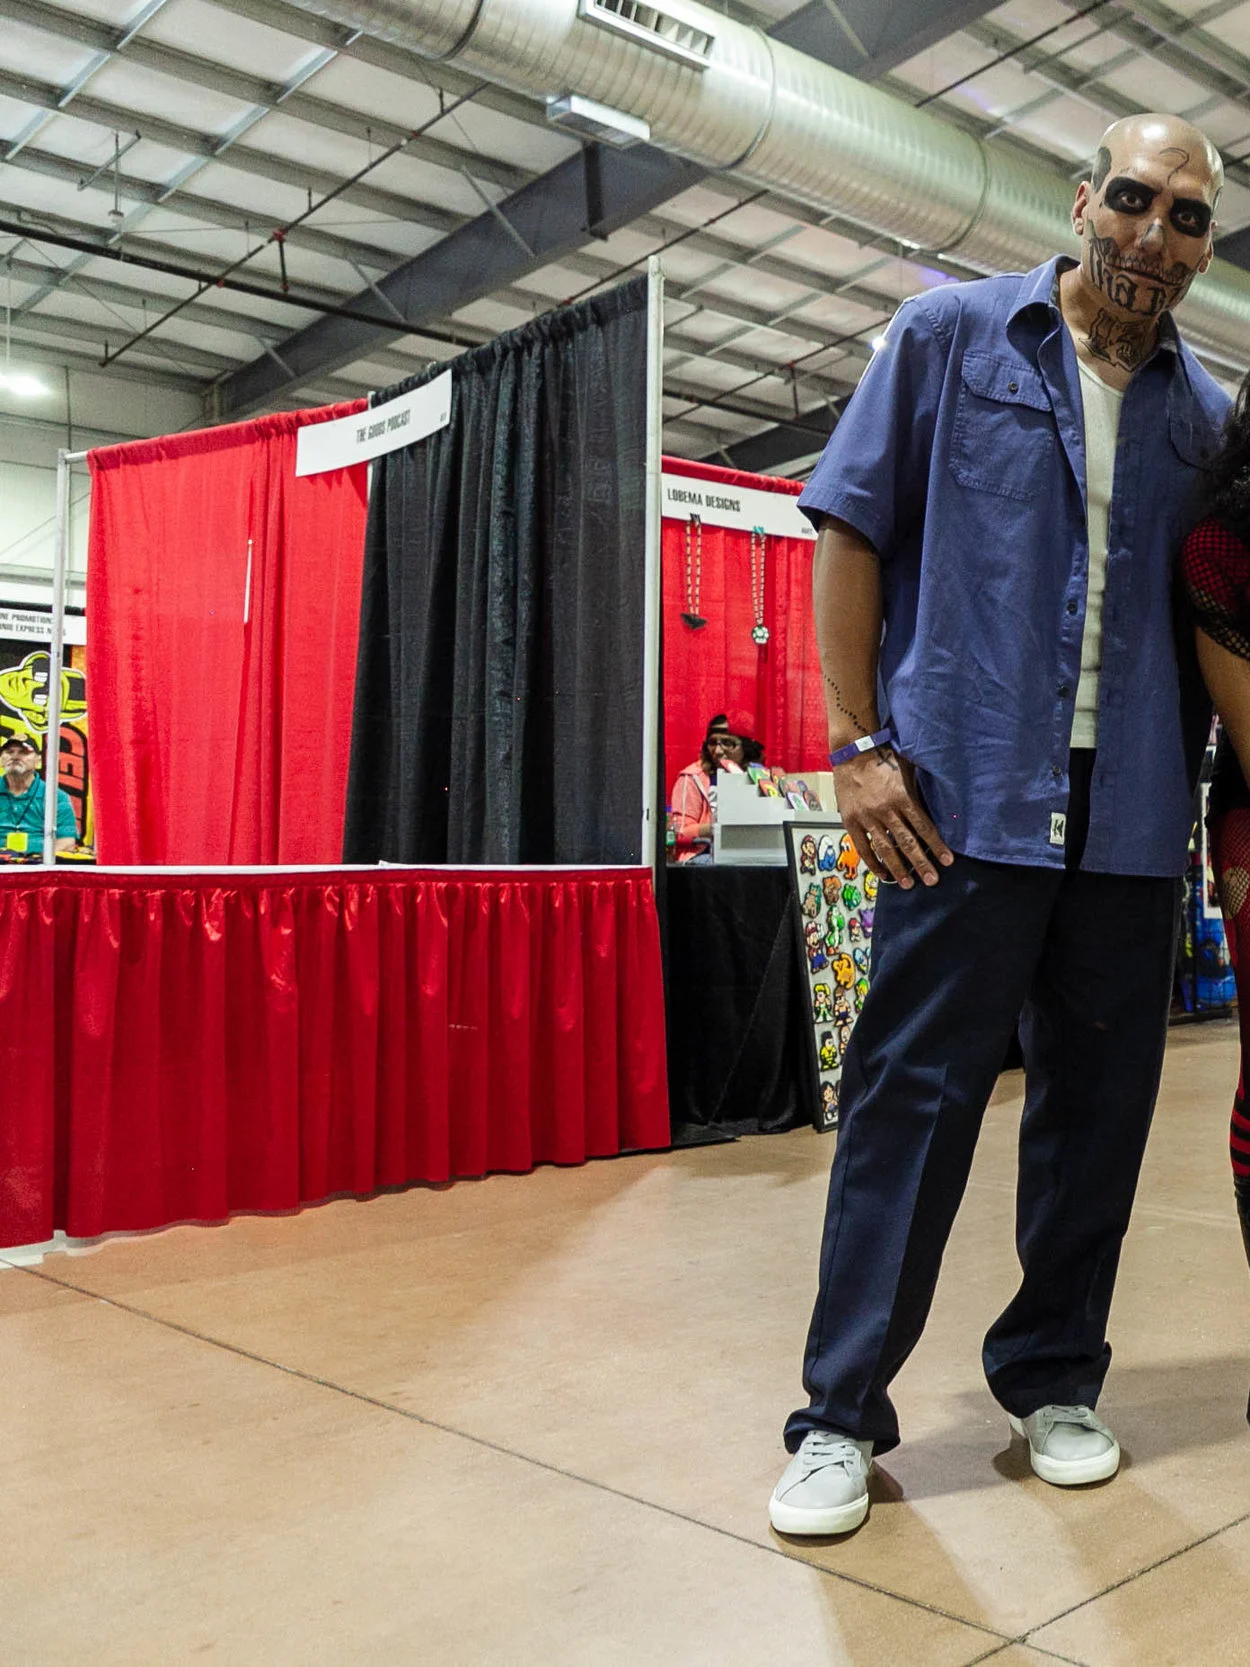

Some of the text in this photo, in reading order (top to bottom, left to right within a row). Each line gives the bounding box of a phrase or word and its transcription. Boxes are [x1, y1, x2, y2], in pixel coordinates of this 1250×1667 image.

[357, 426, 367, 442] THE
[706, 495, 741, 512] DESIGNS
[12, 613, 54, 625] PROMOTION
